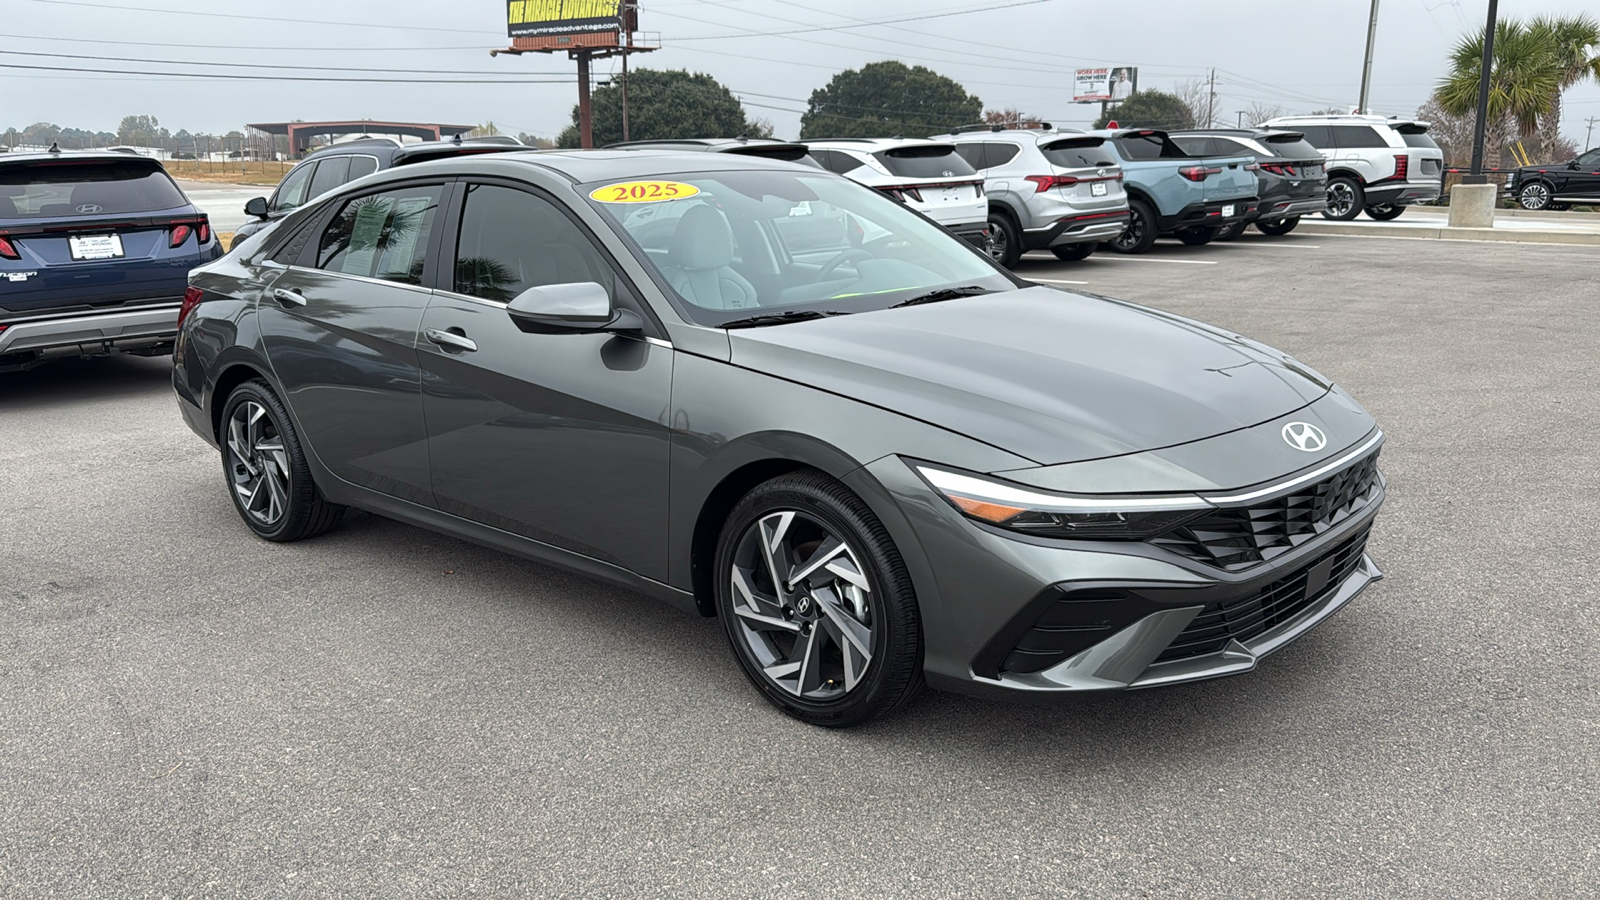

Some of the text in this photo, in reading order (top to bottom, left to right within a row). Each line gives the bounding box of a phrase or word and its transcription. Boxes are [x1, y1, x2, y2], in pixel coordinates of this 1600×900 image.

[509, 1, 525, 24] THE
[524, 0, 562, 23] MIRACLE
[511, 22, 619, 35] www.mymiracleadvantage.com
[612, 183, 679, 201] 2025
